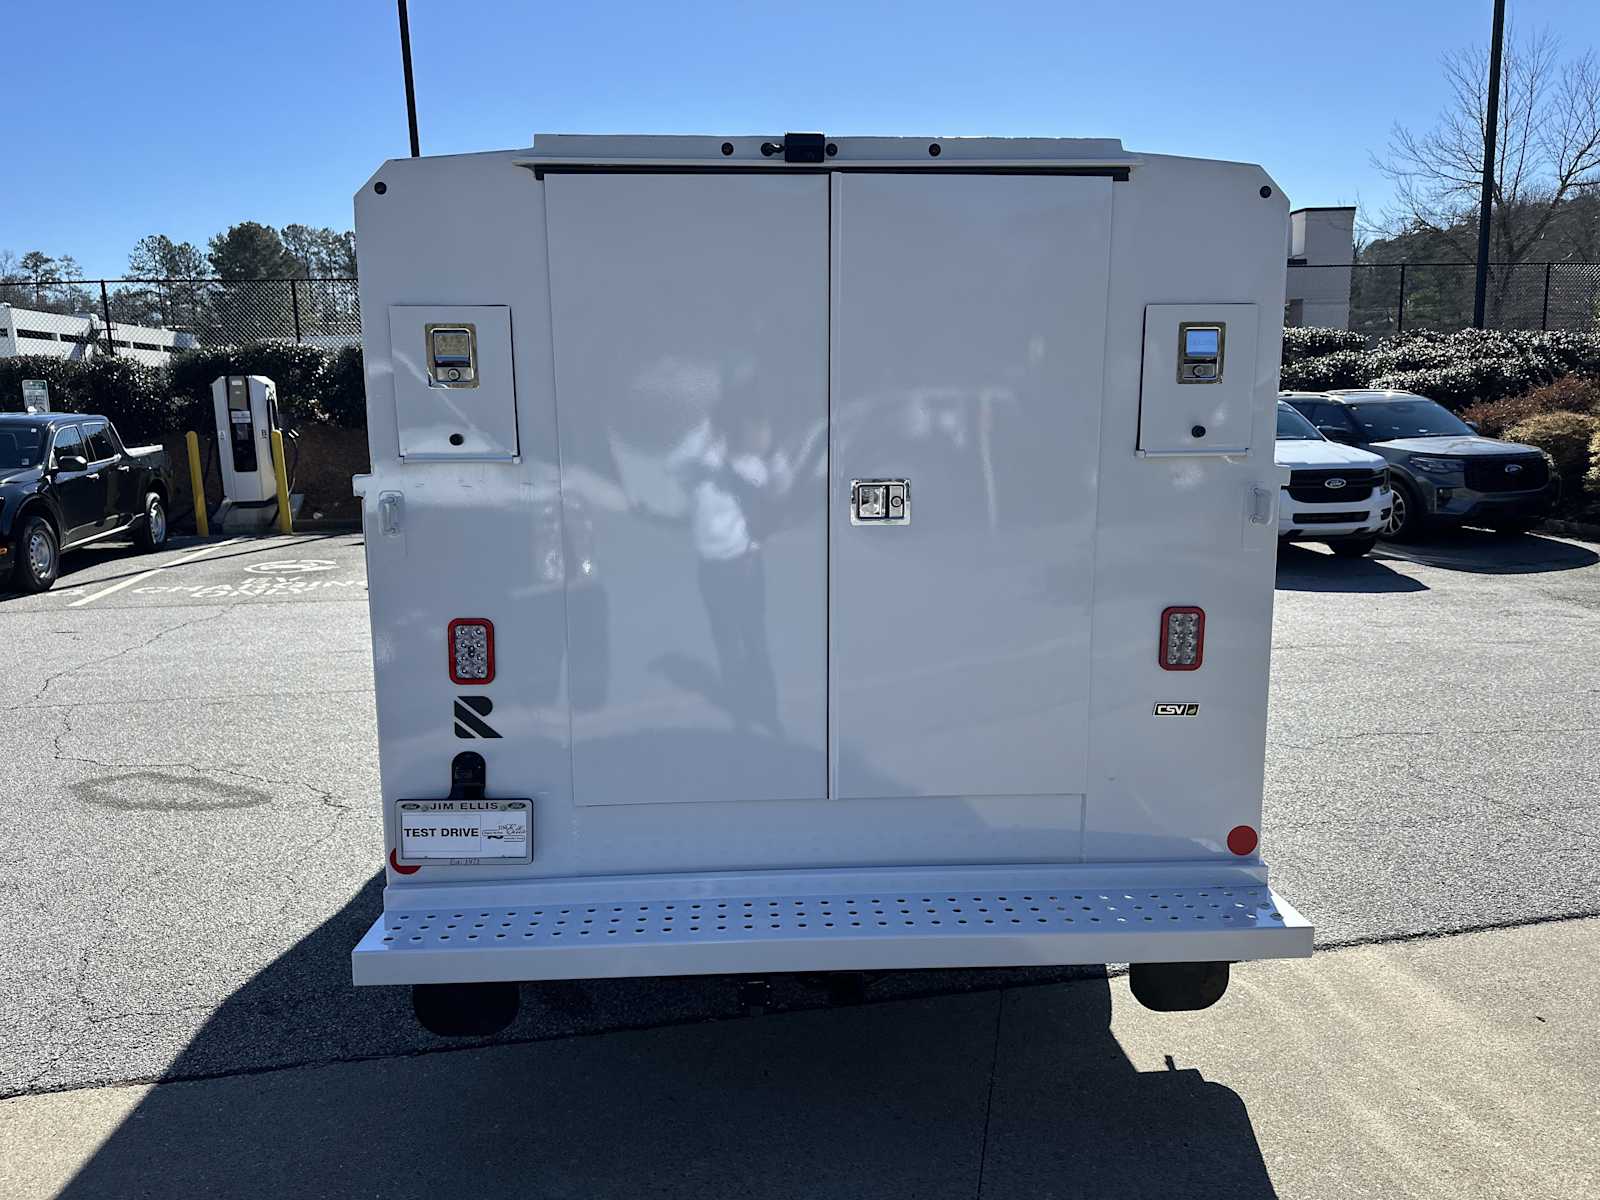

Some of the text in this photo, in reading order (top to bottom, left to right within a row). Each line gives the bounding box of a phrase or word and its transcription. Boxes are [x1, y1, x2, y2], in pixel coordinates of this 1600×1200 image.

[1157, 704, 1185, 715] CSV
[430, 802, 454, 810] JIM
[460, 802, 499, 810] ELLIS
[404, 827, 479, 838] TEST DRIVE
